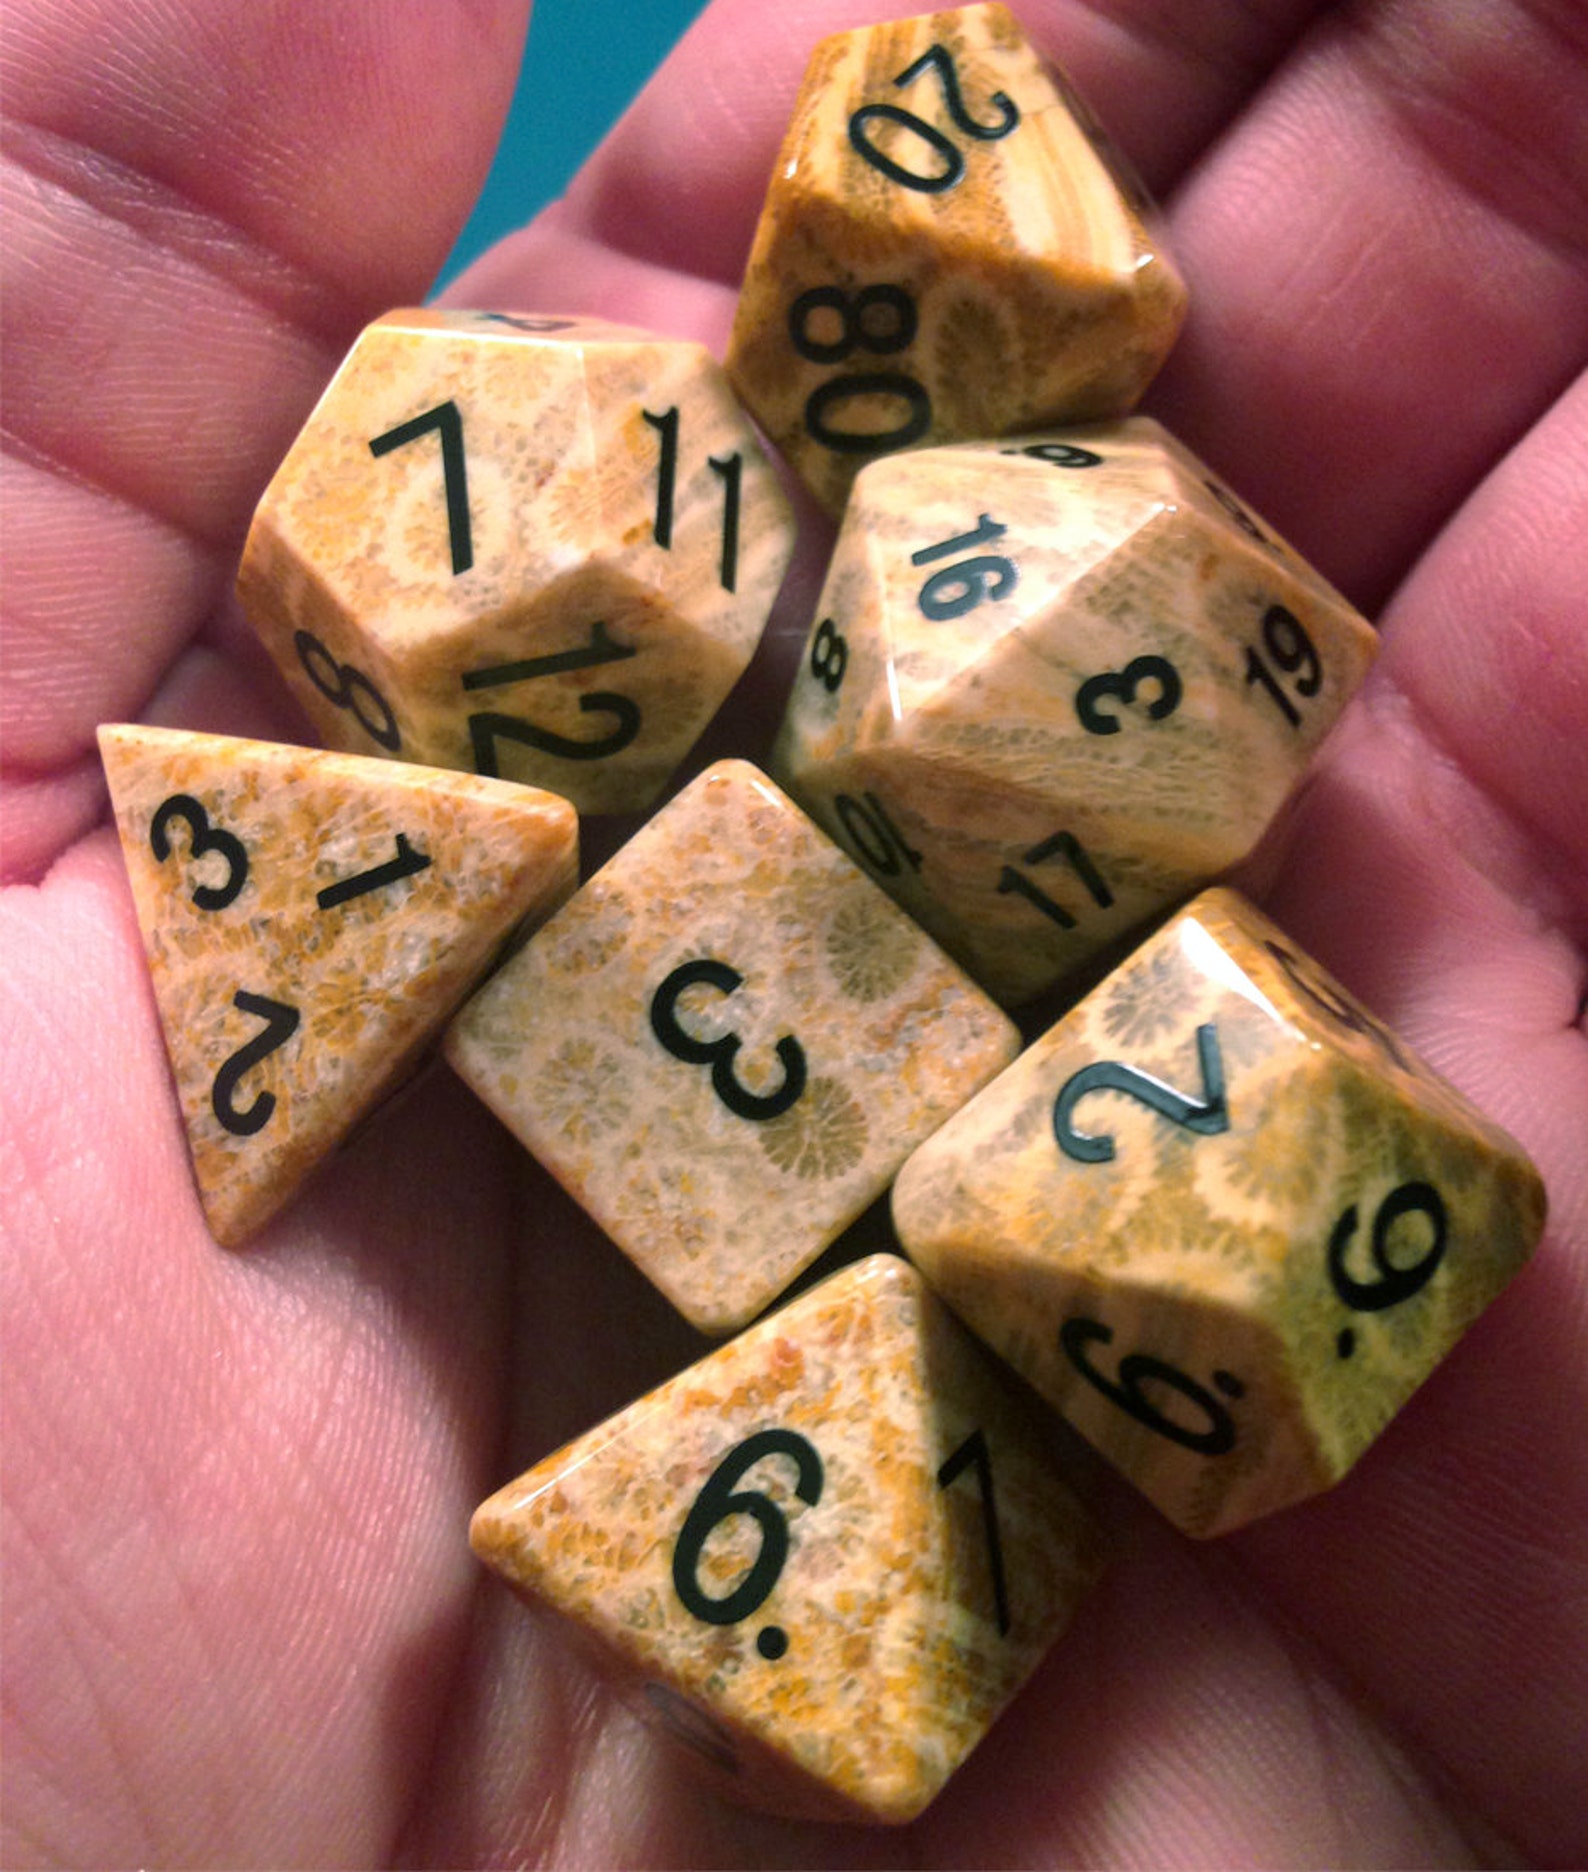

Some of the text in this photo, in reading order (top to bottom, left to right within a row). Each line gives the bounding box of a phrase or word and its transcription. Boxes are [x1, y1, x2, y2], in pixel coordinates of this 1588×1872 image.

[848, 44, 1020, 193] 20
[788, 283, 932, 453] 80
[368, 400, 474, 576] 7
[643, 405, 742, 594] 11
[911, 513, 1020, 622] 16
[295, 629, 400, 752] 8
[461, 621, 643, 778] 12
[810, 618, 848, 694] 8
[1075, 655, 1182, 736] 3
[1245, 604, 1323, 728] 19
[149, 793, 249, 912] 3
[316, 832, 432, 911] 1
[997, 830, 1114, 930] 17
[211, 989, 300, 1137] 2
[650, 958, 808, 1122] 3
[1053, 1022, 1229, 1164] 2
[937, 1428, 1011, 1639] 7
